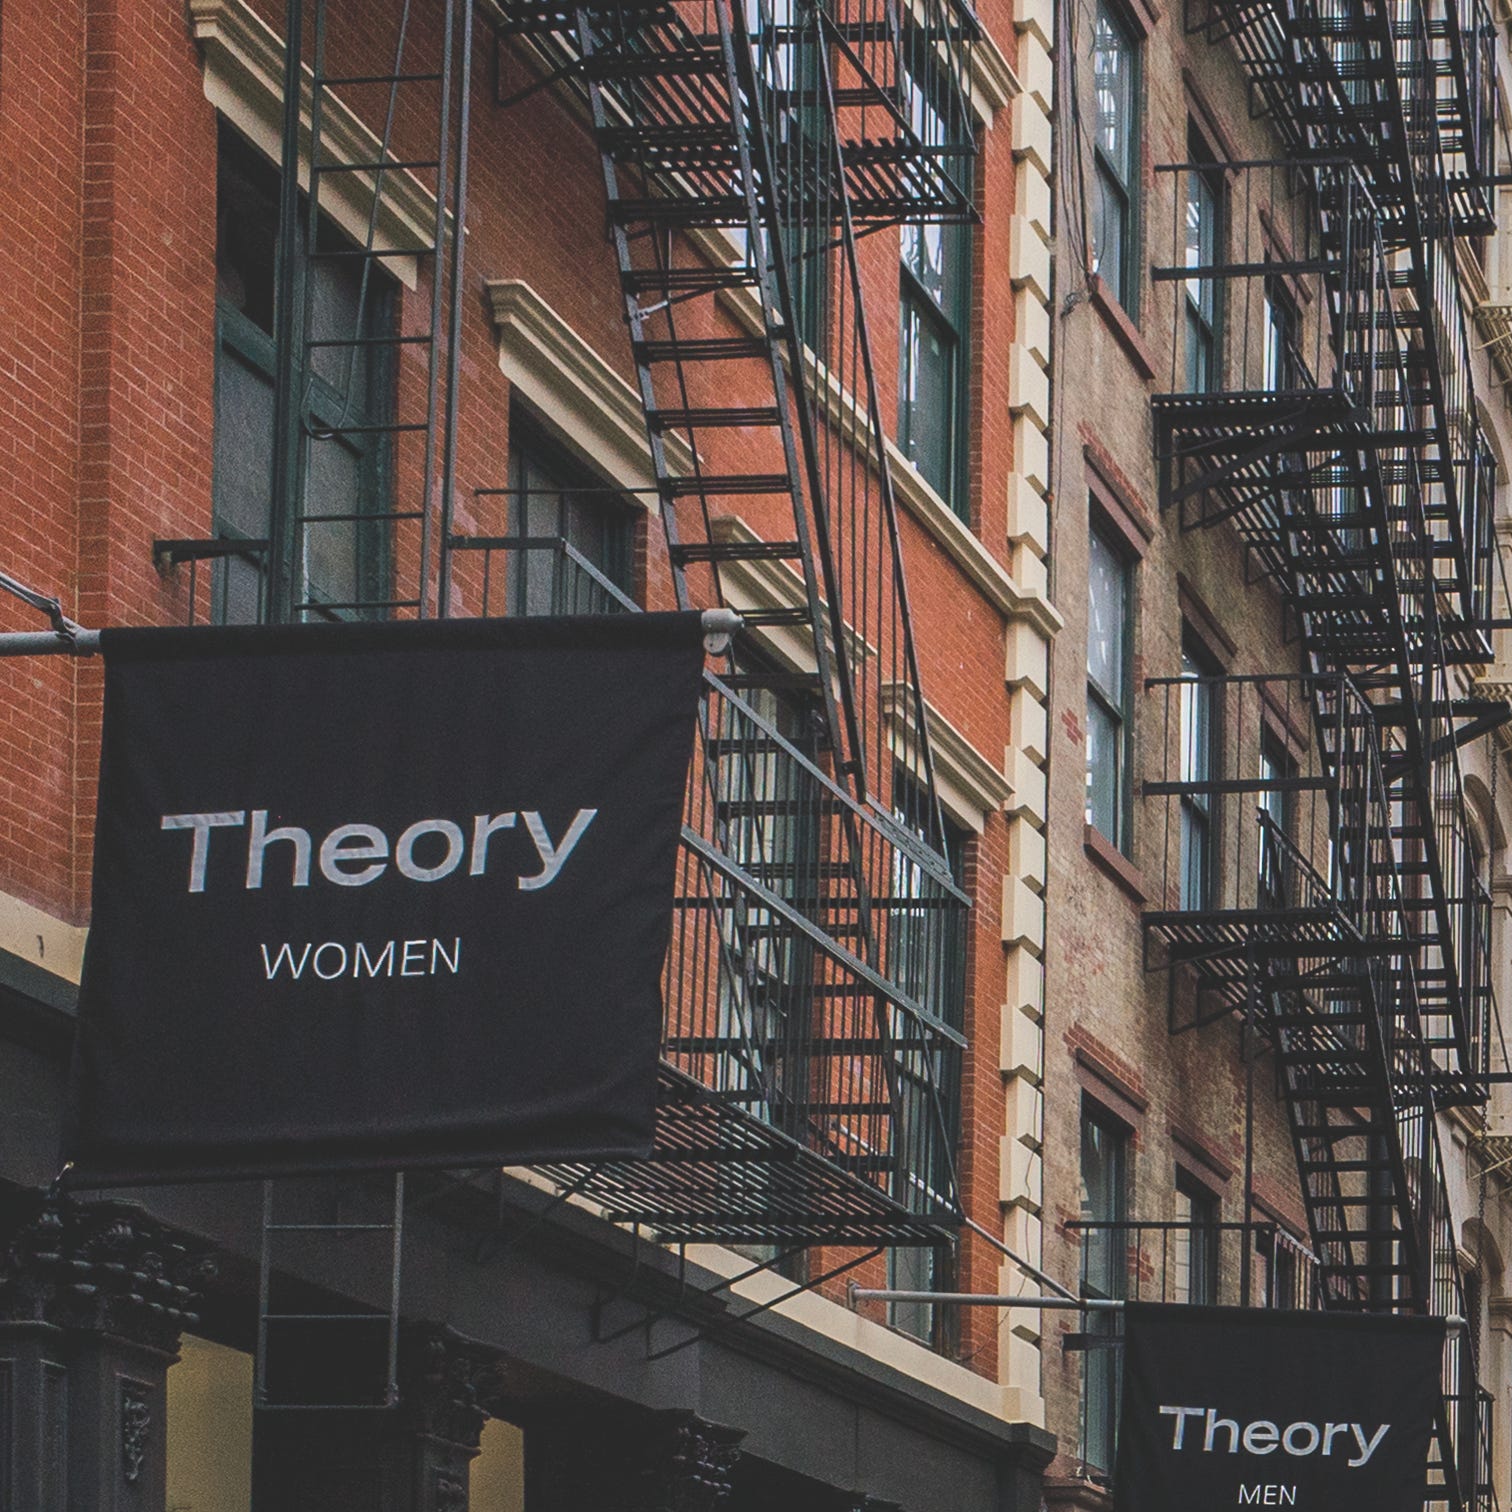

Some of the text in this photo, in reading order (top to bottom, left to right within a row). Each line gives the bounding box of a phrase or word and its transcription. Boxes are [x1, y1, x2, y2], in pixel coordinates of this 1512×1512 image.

[161, 808, 597, 892] Theory
[260, 937, 461, 979] WOMEN
[1159, 1405, 1391, 1467] Theory
[1238, 1483, 1297, 1505] MEN
